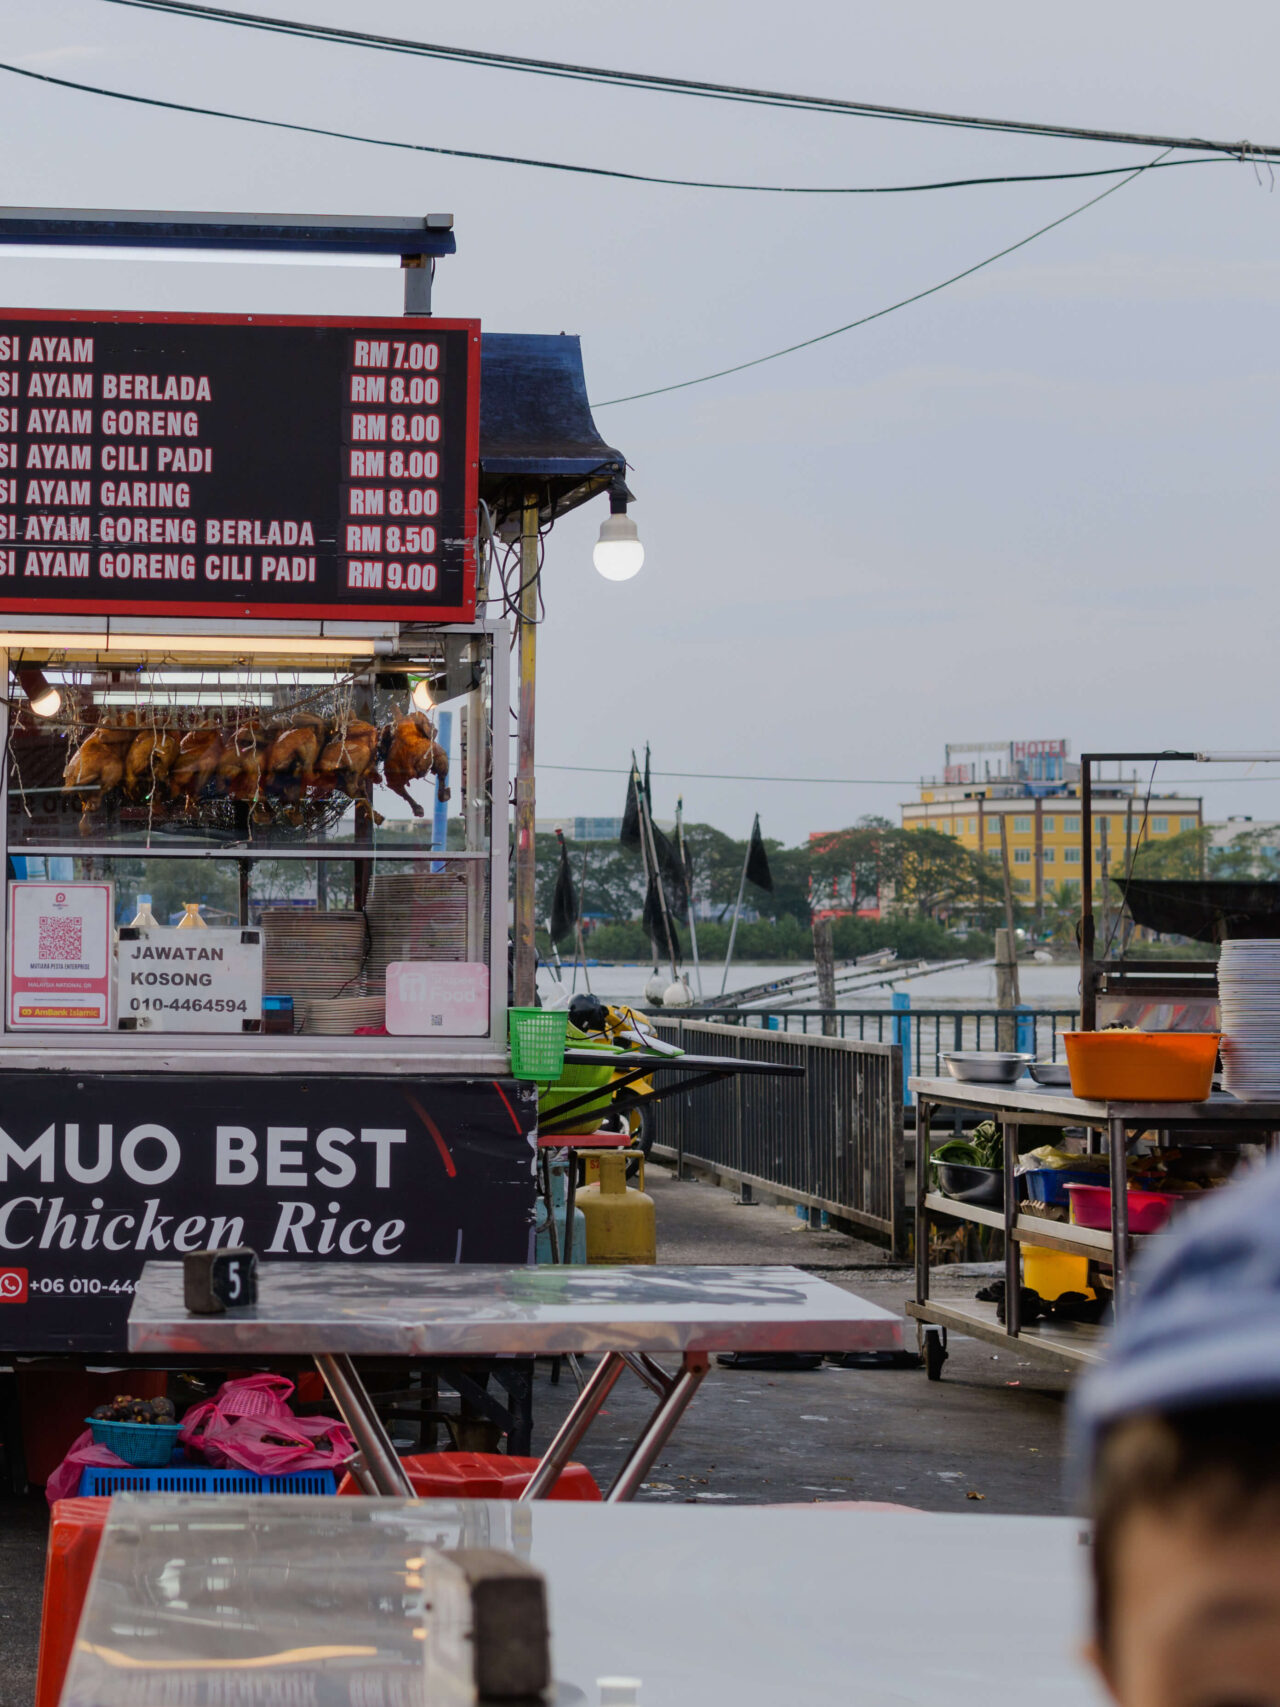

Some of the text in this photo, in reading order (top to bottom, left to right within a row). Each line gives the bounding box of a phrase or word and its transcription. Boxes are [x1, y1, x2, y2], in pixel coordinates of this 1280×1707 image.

[28, 337, 94, 363] AYAM
[354, 340, 439, 371] RM 7.00
[27, 373, 93, 399] AYAM
[102, 374, 212, 401] BERLADA
[350, 375, 440, 405] RM 8.00
[27, 408, 93, 434] AYAM
[102, 410, 199, 437] GORENG
[352, 413, 441, 442] RM 8.00
[26, 444, 92, 470] AYAM
[101, 446, 148, 471] CILI
[157, 447, 213, 473] PADI
[350, 450, 440, 479] RM 8.00
[25, 480, 91, 506] AYAM
[100, 481, 191, 508] GARING
[349, 487, 439, 516] RM 8.00
[25, 516, 90, 541] AYAM
[99, 517, 196, 544] GORENG
[205, 520, 315, 546] BERLADA
[346, 525, 436, 553] RM 8.50
[24, 552, 90, 577] AYAM
[99, 553, 196, 580] GORENG
[205, 555, 252, 581] CILI
[261, 557, 317, 582] PADI
[347, 560, 437, 591] RM 9.00
[1014, 739, 1067, 759] HOTEL
[131, 946, 224, 961] JAWATAN
[130, 972, 212, 987] KOSONG
[130, 997, 247, 1013] 010-4464594
[430, 986, 476, 1003] Food
[34, 1008, 98, 1017] AmBank Islamic
[215, 1125, 407, 1188] BEST
[264, 1201, 406, 1256] Rice
[29, 1278, 65, 1293] +06
[228, 1261, 242, 1299] 5
